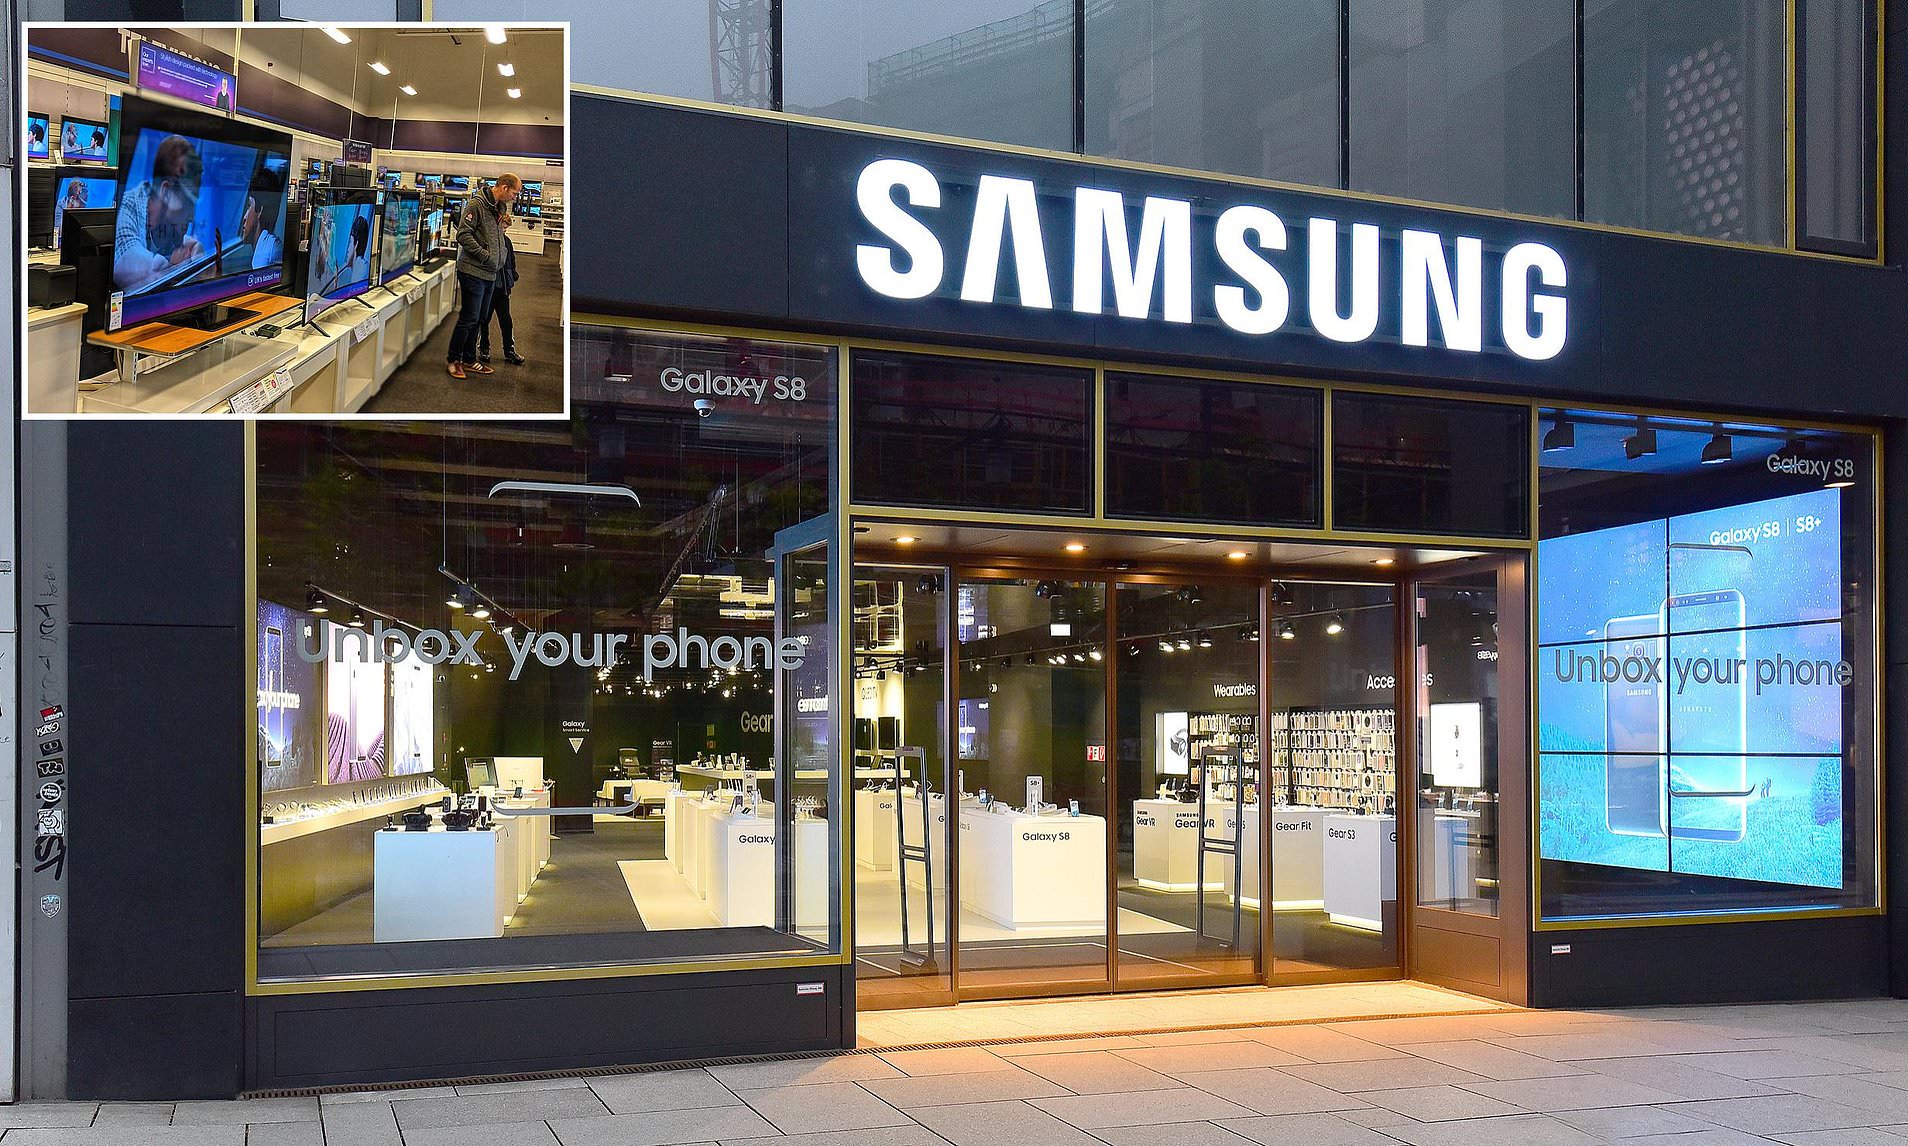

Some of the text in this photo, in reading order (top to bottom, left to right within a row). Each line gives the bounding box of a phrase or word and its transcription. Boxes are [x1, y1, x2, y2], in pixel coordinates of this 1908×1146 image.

[856, 158, 1568, 361] SAMSUNG
[660, 367, 806, 405] Galaxy S8
[1767, 454, 1855, 481] Galaxy S8
[1709, 515, 1822, 545] Galaxy S8 S8+
[296, 618, 806, 683] Unbox your phone
[1555, 649, 1854, 696] Unbox your phone
[1213, 682, 1257, 698] Wearables
[562, 720, 585, 729] Galaxy
[741, 710, 774, 733] Gear
[1136, 816, 1149, 826] Gear
[1275, 821, 1312, 831] Gear Fit
[739, 834, 775, 845] Galaxy
[1022, 831, 1070, 842] Galaxy S8
[1328, 827, 1356, 840] Gear S3
